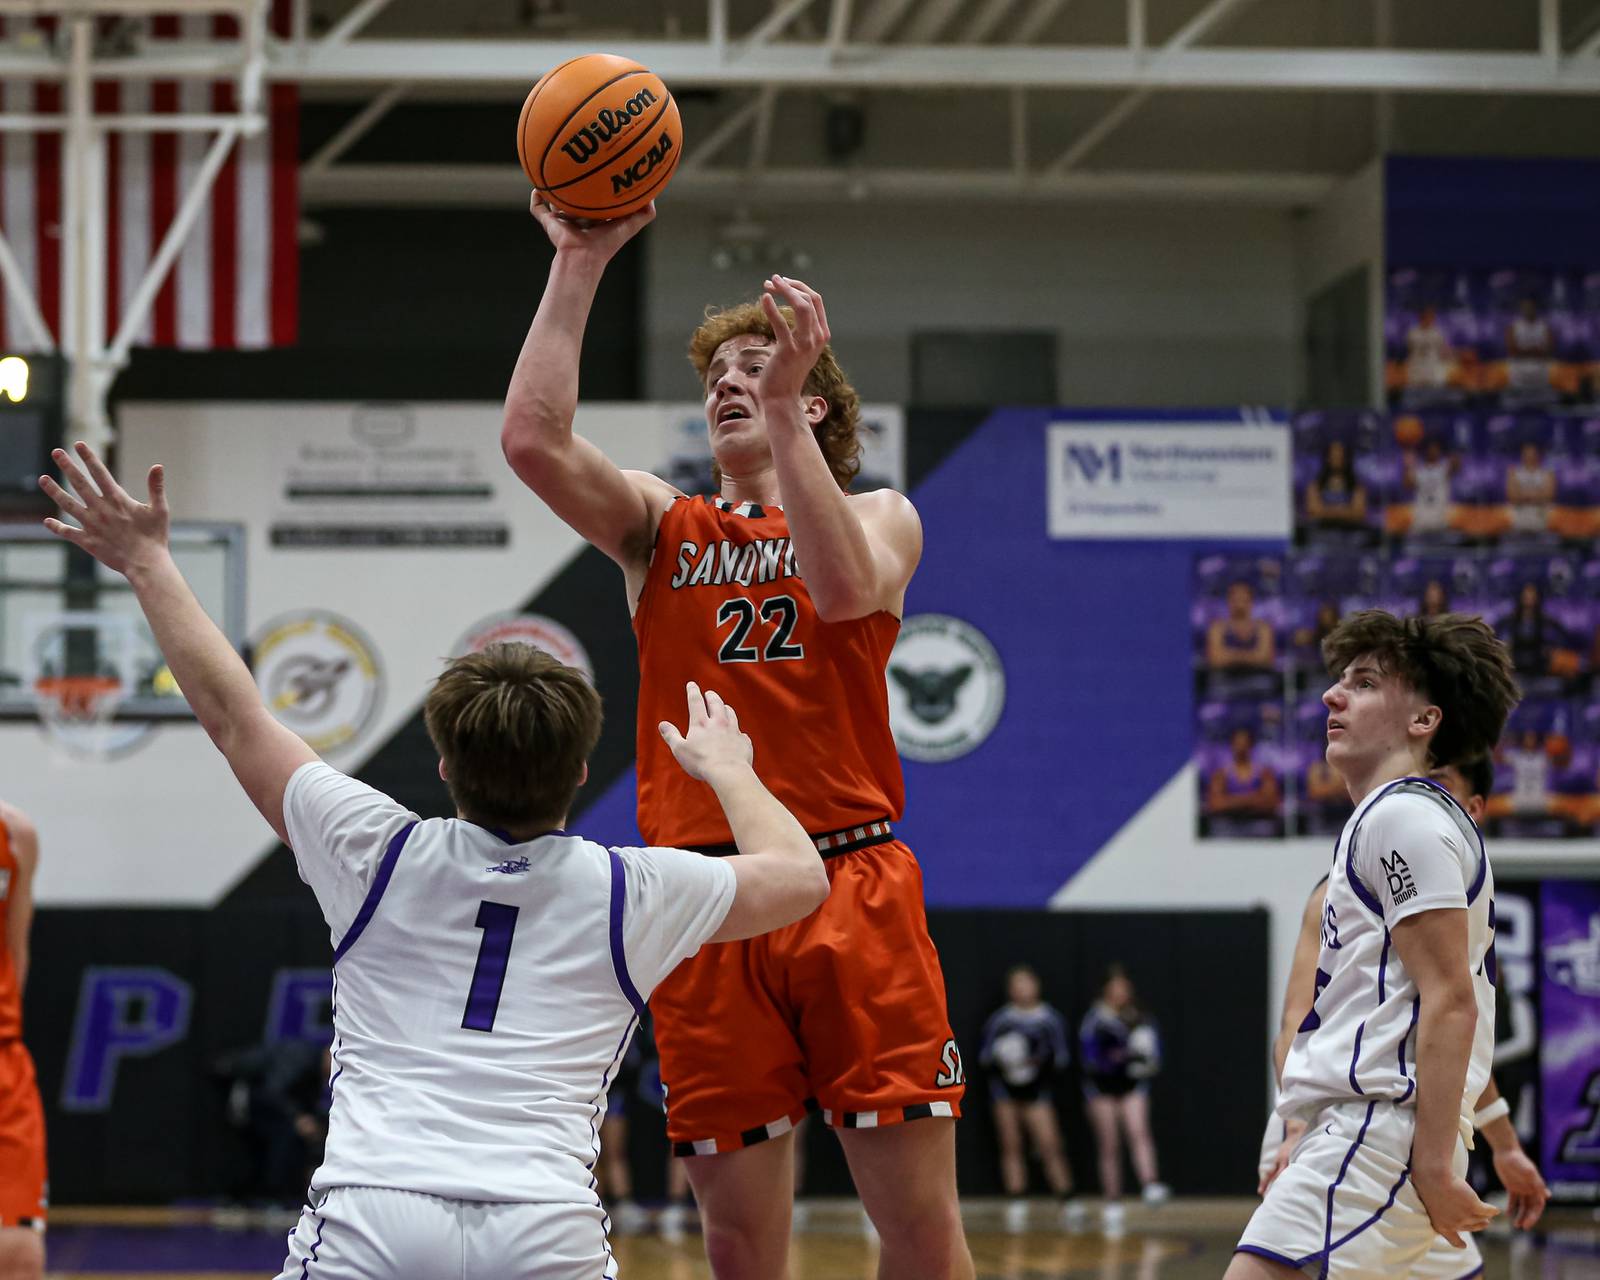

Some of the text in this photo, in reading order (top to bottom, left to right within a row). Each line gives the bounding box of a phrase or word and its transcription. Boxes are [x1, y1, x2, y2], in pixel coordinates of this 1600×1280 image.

[560, 88, 660, 164] Wilson
[611, 131, 673, 194] NCAA
[671, 538, 802, 590] SANDWI
[716, 595, 804, 663] 22
[1393, 887, 1418, 906] HOOPS
[461, 900, 520, 1032] 1
